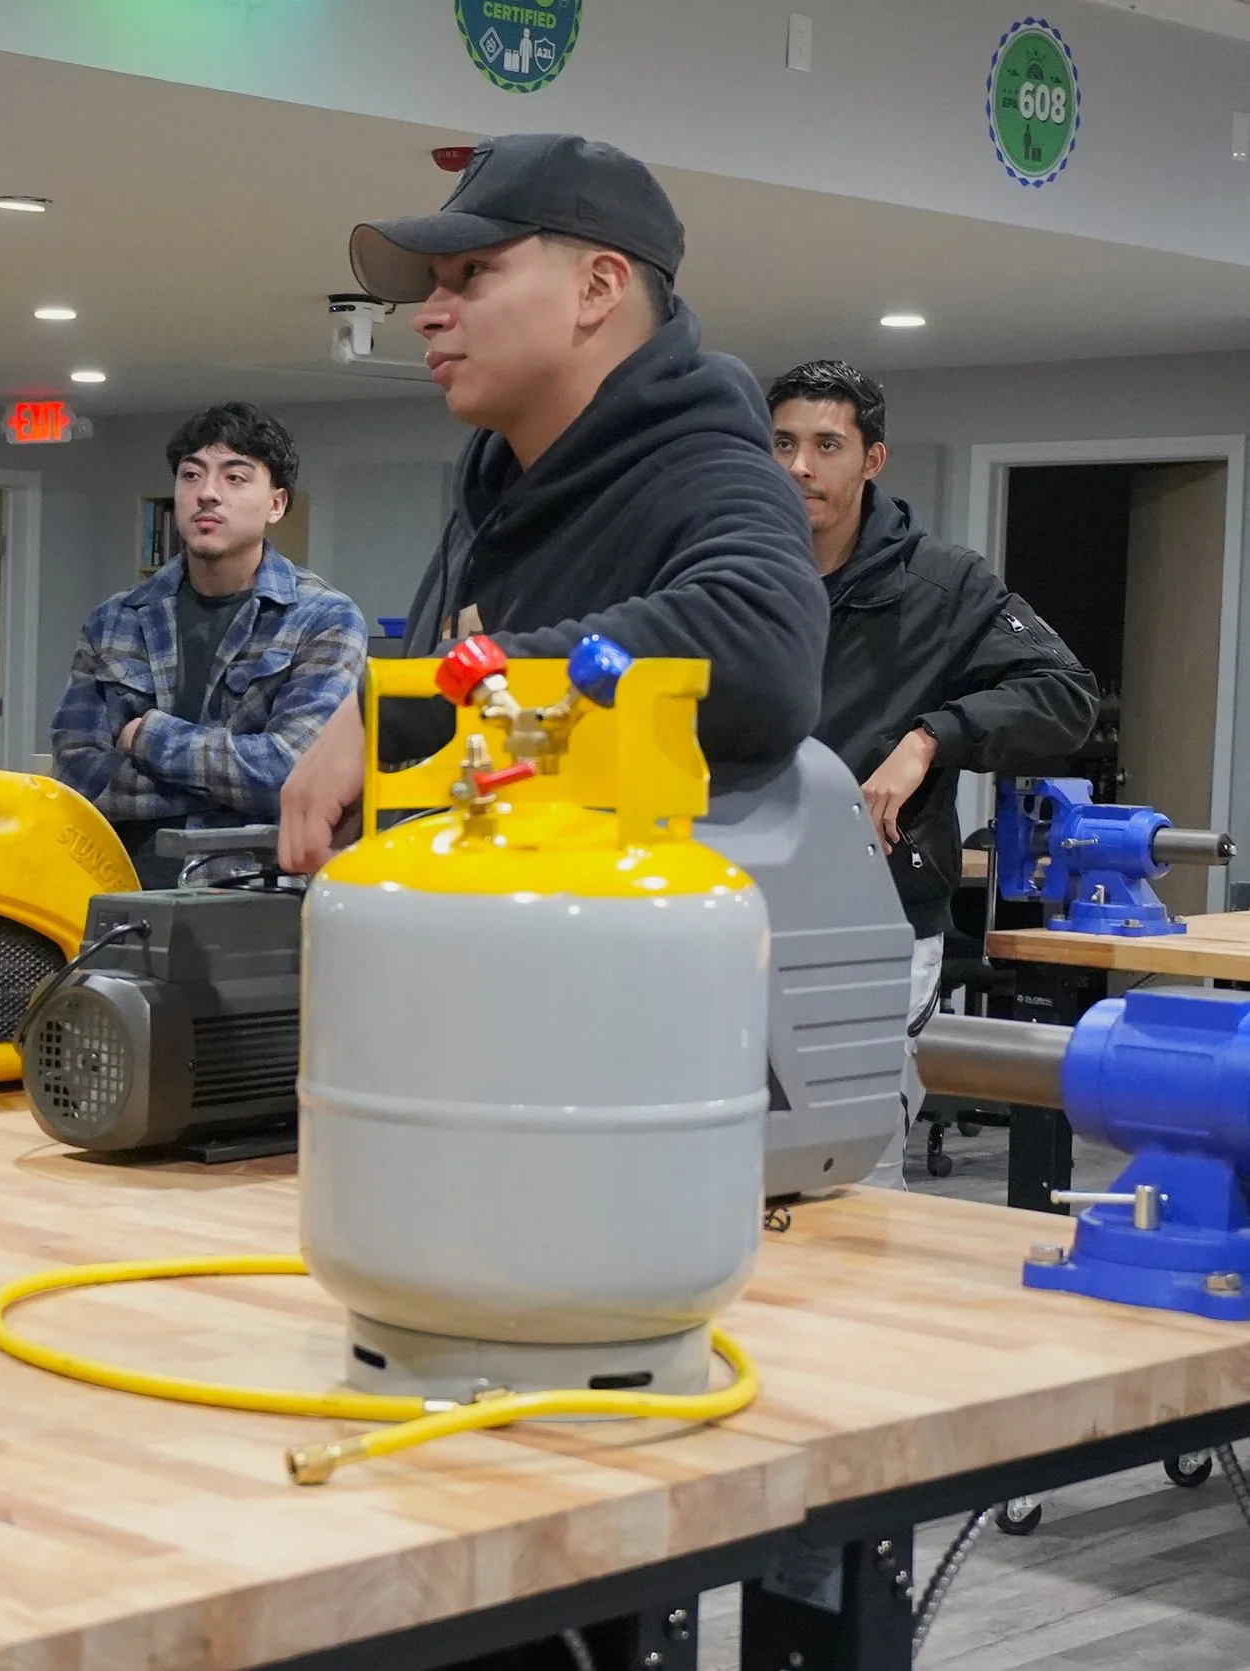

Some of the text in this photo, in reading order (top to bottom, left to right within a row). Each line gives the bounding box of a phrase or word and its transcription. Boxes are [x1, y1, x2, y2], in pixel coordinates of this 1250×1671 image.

[483, 1, 557, 29] CERTIFIED
[536, 47, 553, 59] A2L
[1019, 81, 1066, 124] 608
[16, 402, 64, 441] EXIT
